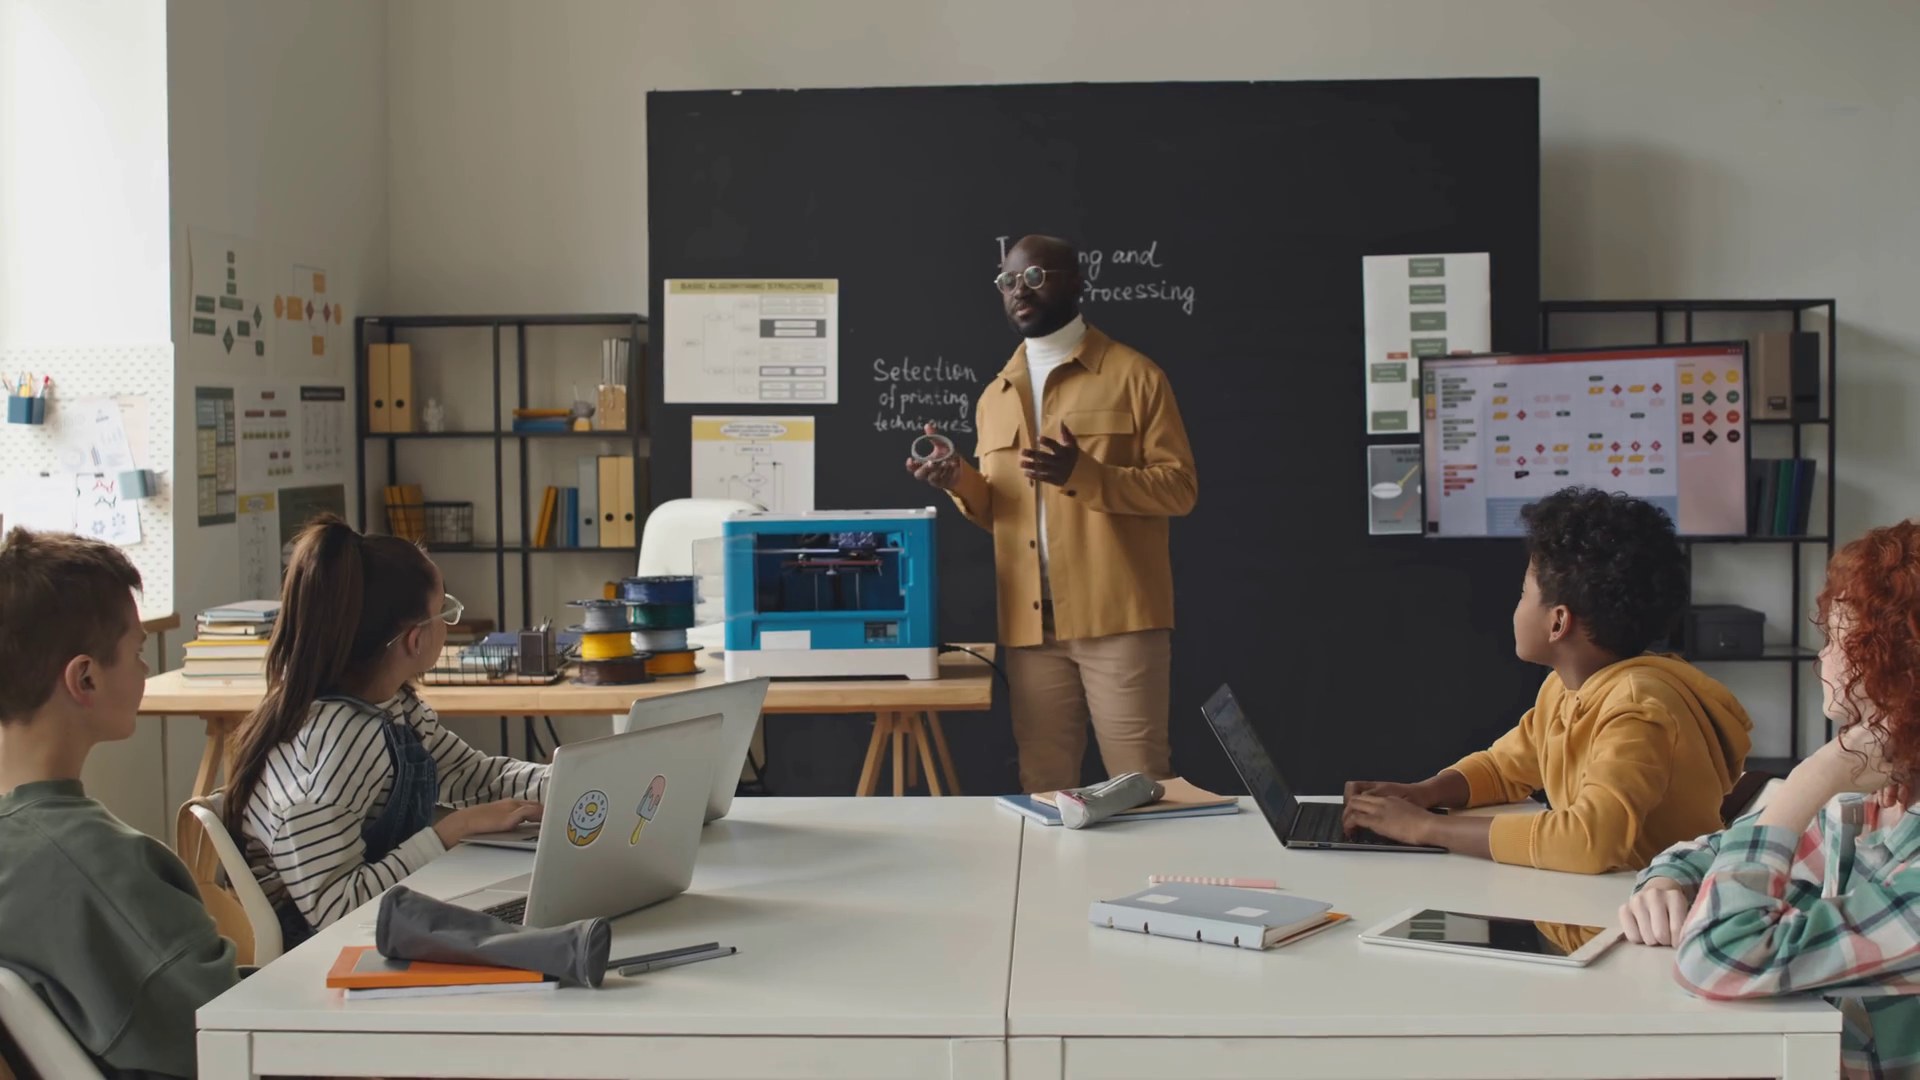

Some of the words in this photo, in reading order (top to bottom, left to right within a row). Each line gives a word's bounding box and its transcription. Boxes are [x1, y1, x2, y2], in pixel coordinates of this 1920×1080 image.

[1112, 241, 1163, 268] and
[879, 383, 897, 409] of
[900, 389, 969, 419] printing
